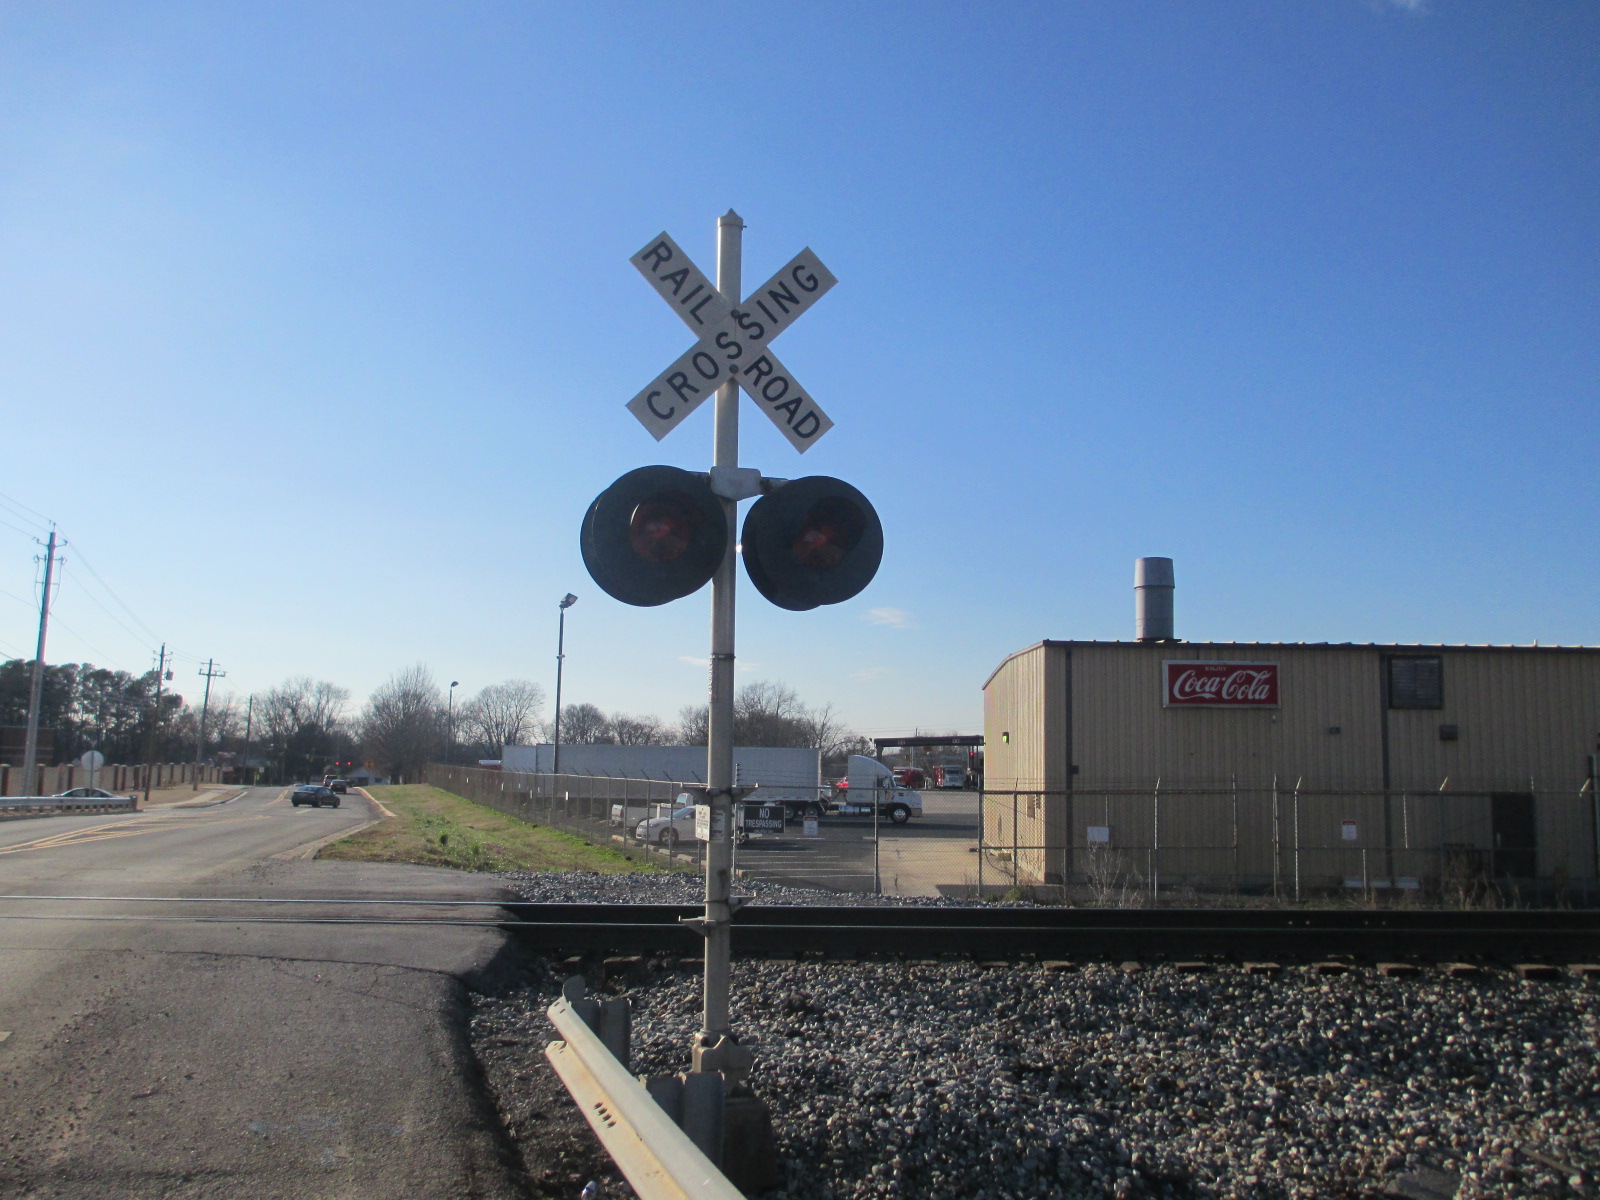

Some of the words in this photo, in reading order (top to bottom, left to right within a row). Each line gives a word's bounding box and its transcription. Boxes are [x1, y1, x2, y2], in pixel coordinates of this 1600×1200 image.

[641, 240, 714, 326] RAIL
[743, 354, 821, 439] ROAD
[646, 264, 820, 421] CROSSING
[745, 819, 782, 828] TRESPASSING
[759, 807, 770, 819] NO
